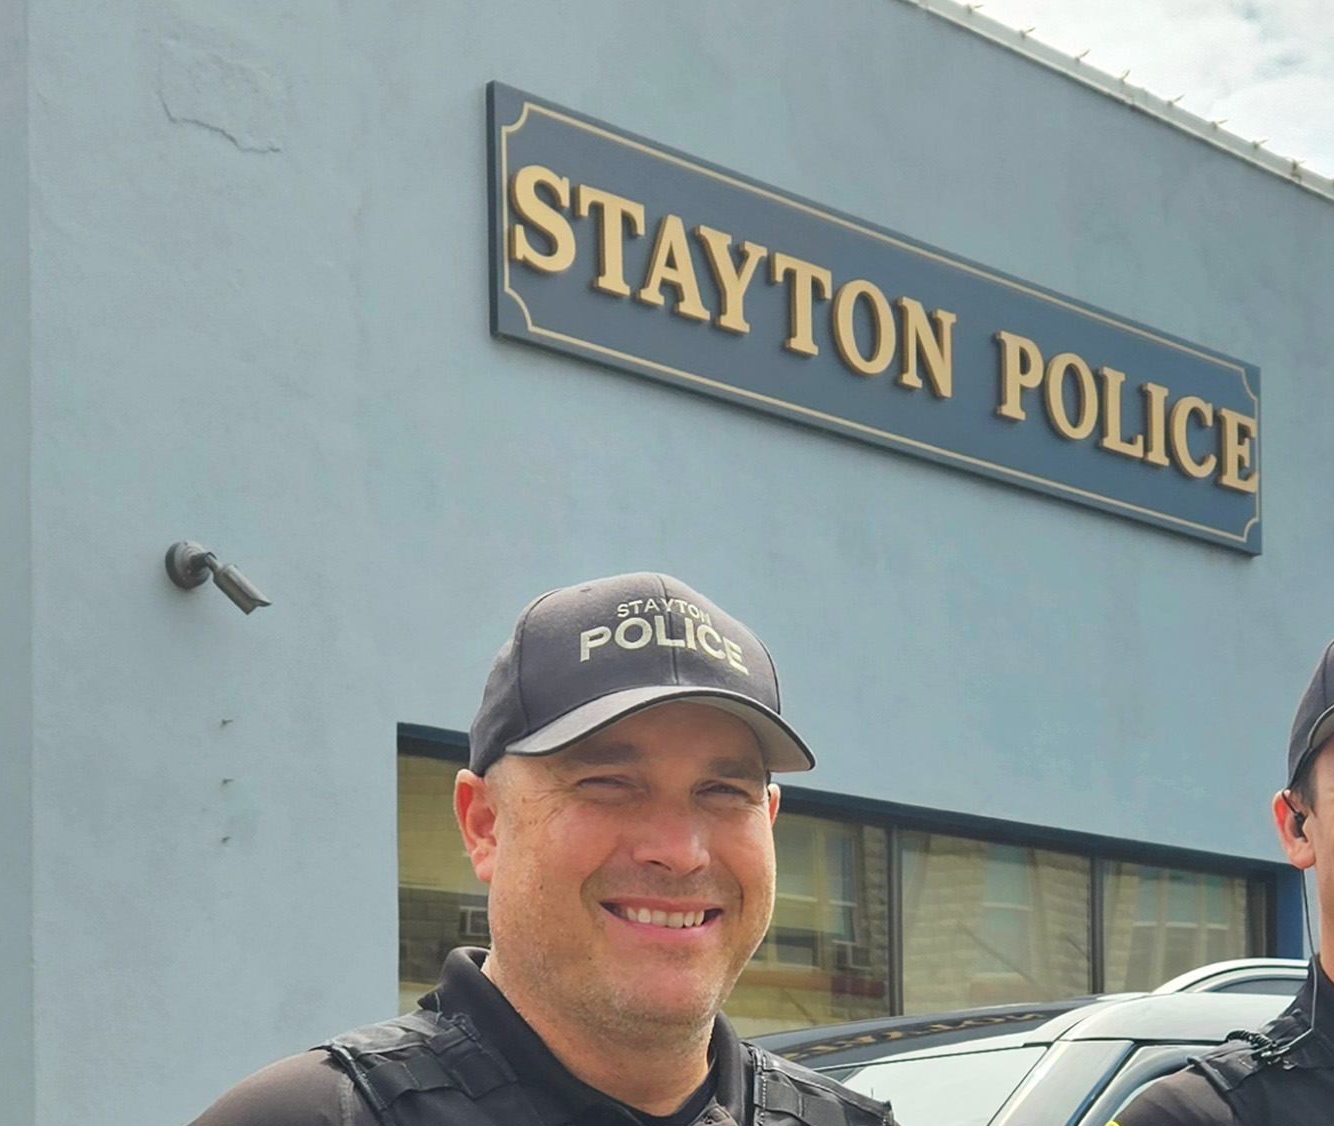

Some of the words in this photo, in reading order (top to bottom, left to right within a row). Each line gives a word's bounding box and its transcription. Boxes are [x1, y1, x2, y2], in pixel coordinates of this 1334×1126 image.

[509, 164, 957, 400] STAYTON
[995, 330, 1260, 495] POLICE
[617, 598, 713, 627] STAYTON
[579, 615, 750, 677] POLICE
